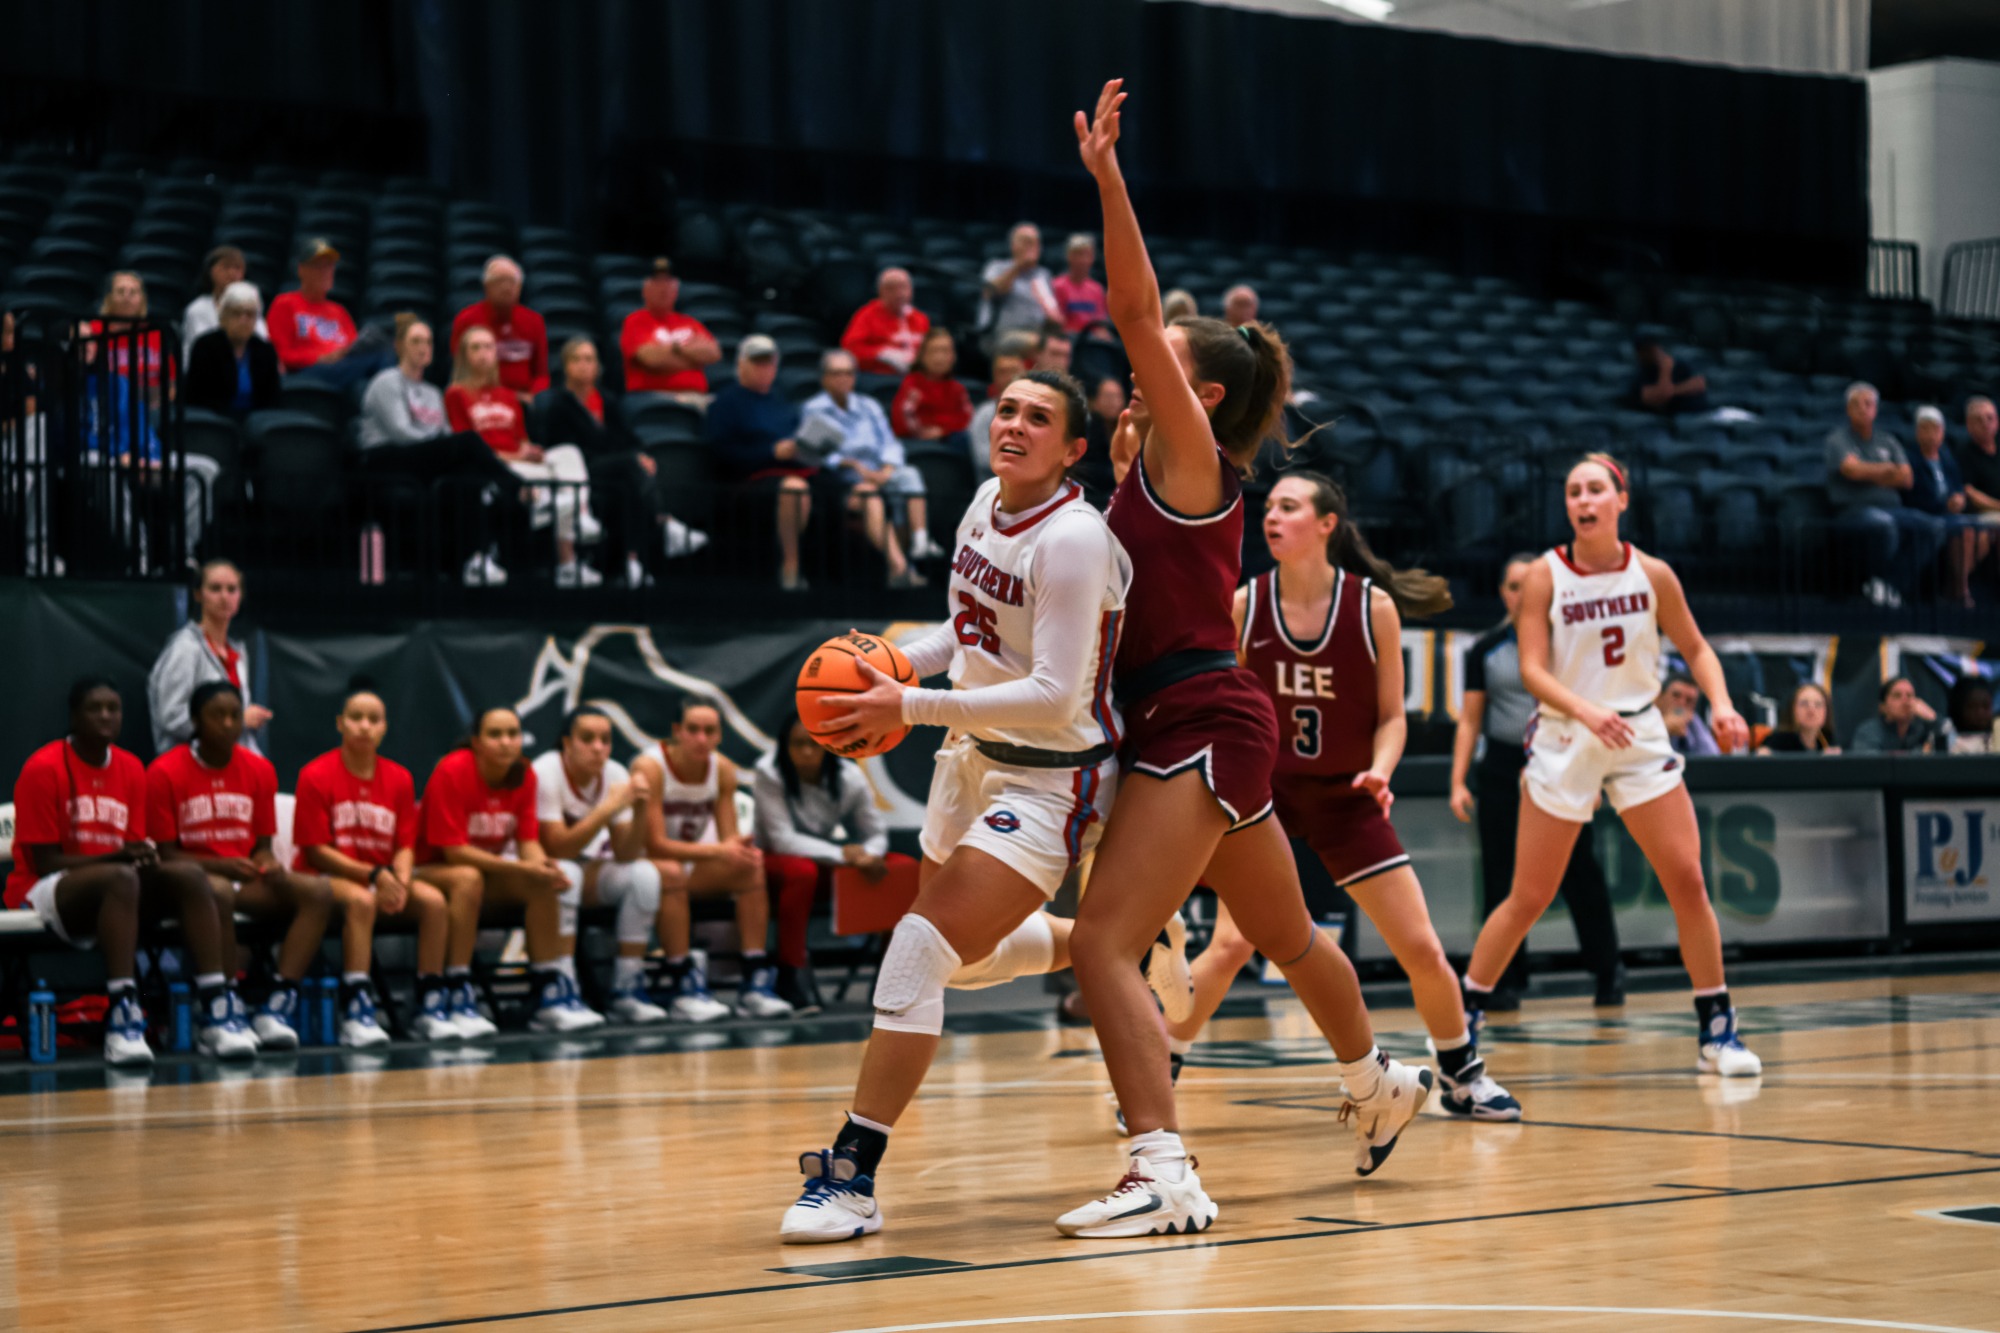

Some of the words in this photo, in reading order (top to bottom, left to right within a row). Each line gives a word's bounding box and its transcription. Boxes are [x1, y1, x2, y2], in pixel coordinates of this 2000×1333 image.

[954, 590, 1001, 656] 25
[1601, 625, 1626, 668] 2
[1275, 661, 1337, 699] LEE
[1291, 705, 1322, 759] 3
